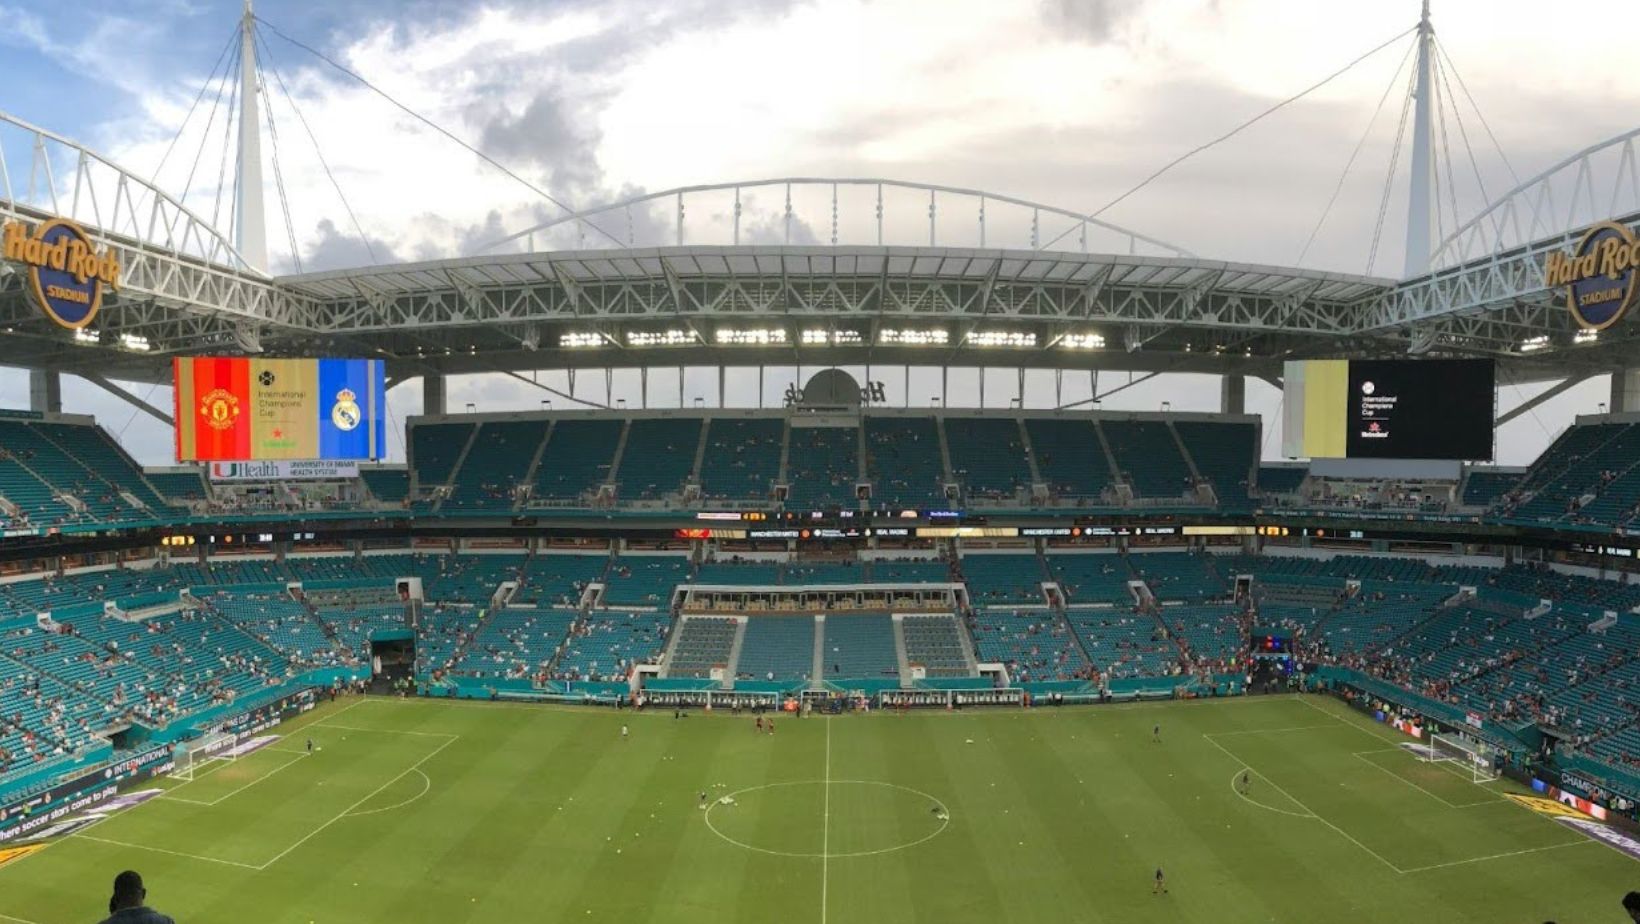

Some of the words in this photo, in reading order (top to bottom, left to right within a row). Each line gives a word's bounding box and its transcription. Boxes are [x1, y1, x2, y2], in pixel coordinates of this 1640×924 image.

[4, 221, 69, 271] Hard
[67, 239, 121, 291] Rock
[1547, 239, 1600, 288] Hard
[47, 284, 90, 304] STADIUM
[1581, 287, 1620, 305] STADIUM
[258, 391, 307, 399] International
[259, 400, 303, 409] Champions
[259, 409, 275, 418] Cup
[1361, 409, 1375, 417] Cup
[22, 812, 49, 832] soccer
[51, 805, 70, 820] stars
[71, 796, 92, 810] come
[93, 791, 102, 802] to
[103, 785, 118, 800] play
